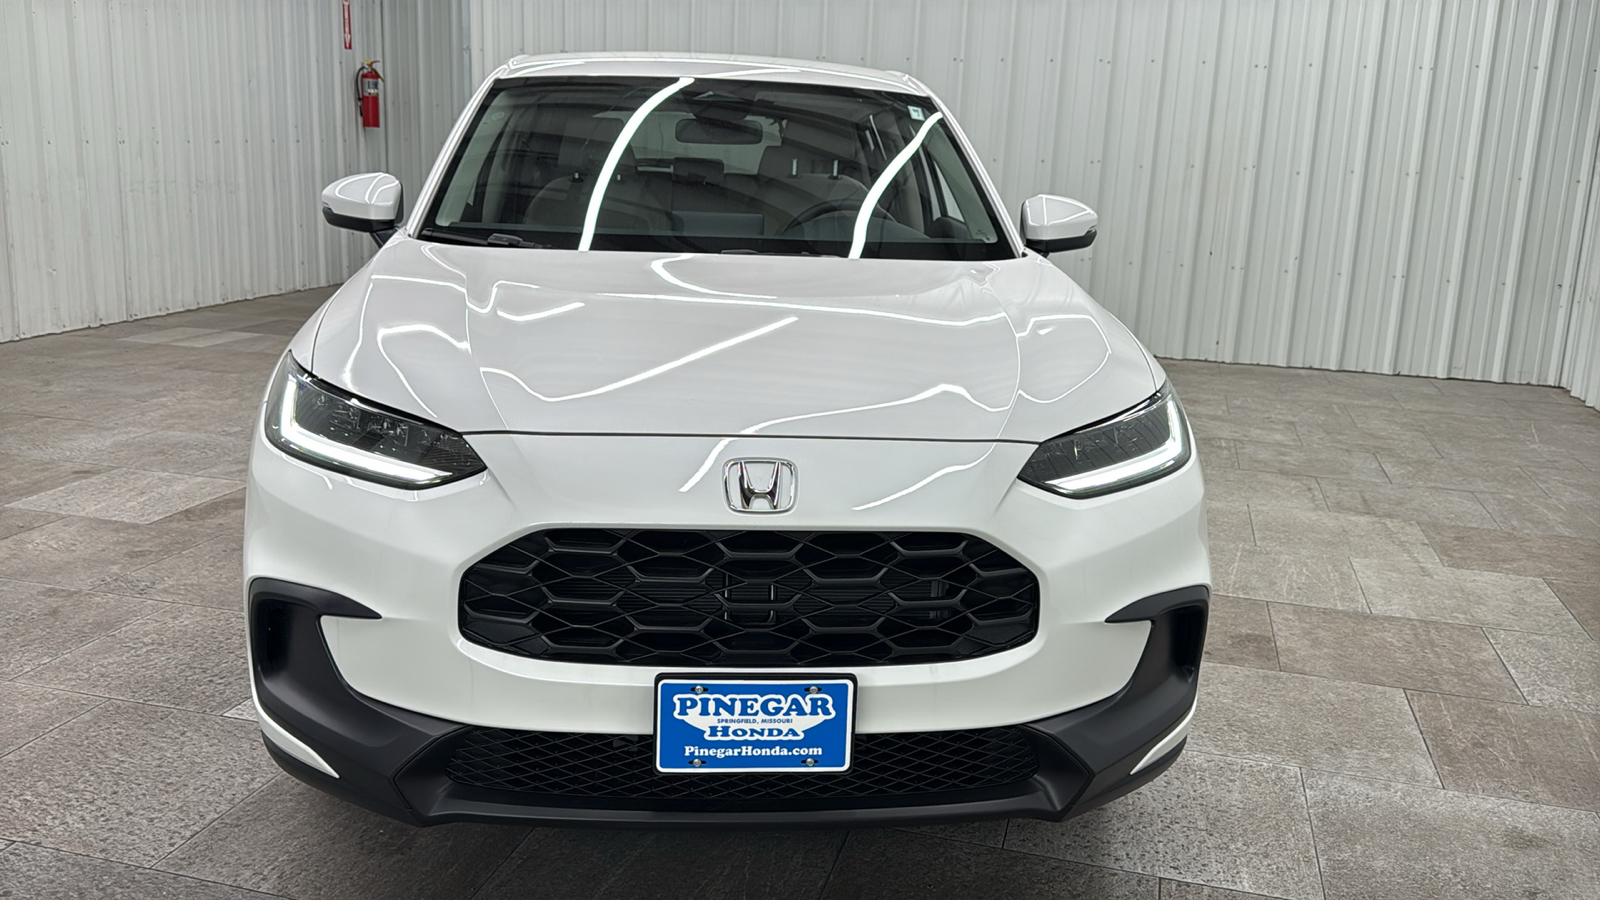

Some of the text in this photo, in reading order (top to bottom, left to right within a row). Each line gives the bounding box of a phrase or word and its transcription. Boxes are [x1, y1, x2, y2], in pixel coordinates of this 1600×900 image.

[677, 697, 831, 716] PINEGAR
[708, 726, 801, 737] HONDA
[684, 745, 822, 758] PinegarHonda.com
